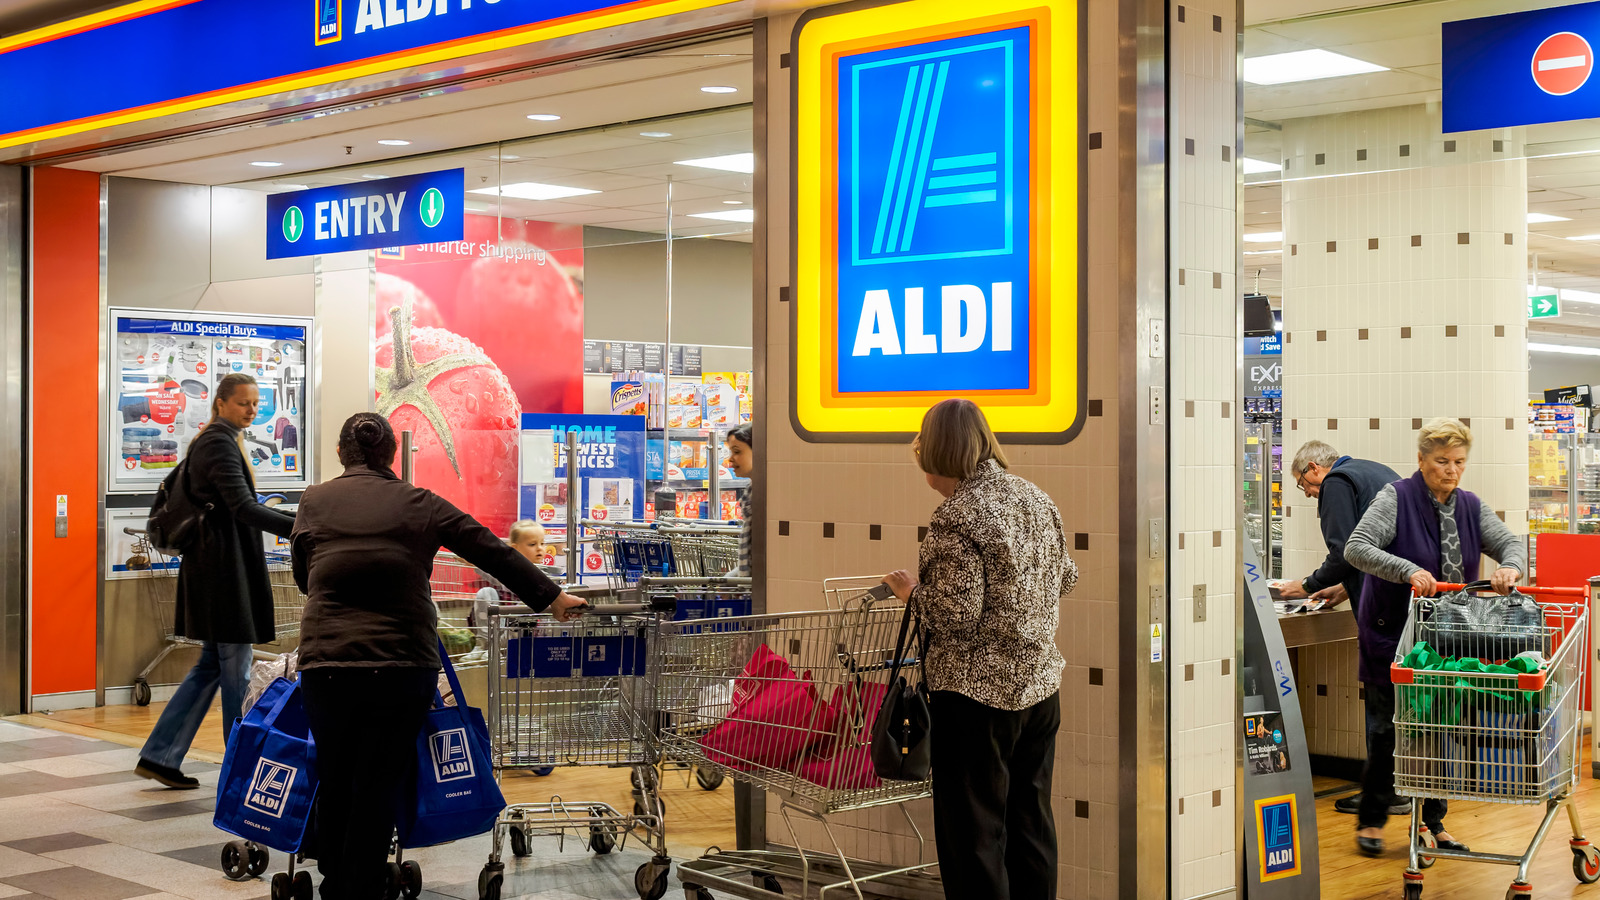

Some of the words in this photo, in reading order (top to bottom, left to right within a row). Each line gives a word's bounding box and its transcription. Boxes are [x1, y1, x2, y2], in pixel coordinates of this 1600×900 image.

[354, 0, 448, 34] AL
[320, 22, 337, 36] ALDI
[315, 191, 406, 240] ENTRY
[417, 240, 475, 256] smarter
[479, 239, 546, 265] shopping
[852, 281, 1012, 356] ALDI
[171, 322, 193, 332] ALDI
[195, 323, 231, 336] Special
[233, 326, 257, 338] Buys
[1265, 343, 1281, 351] Save
[614, 388, 642, 403] Crispetts
[551, 425, 616, 443] HOME
[559, 443, 616, 455] LWEST
[441, 761, 469, 776] ALDI
[250, 792, 280, 810] ALDI
[244, 819, 260, 829] COOLER
[1267, 848, 1293, 866] ALDI
